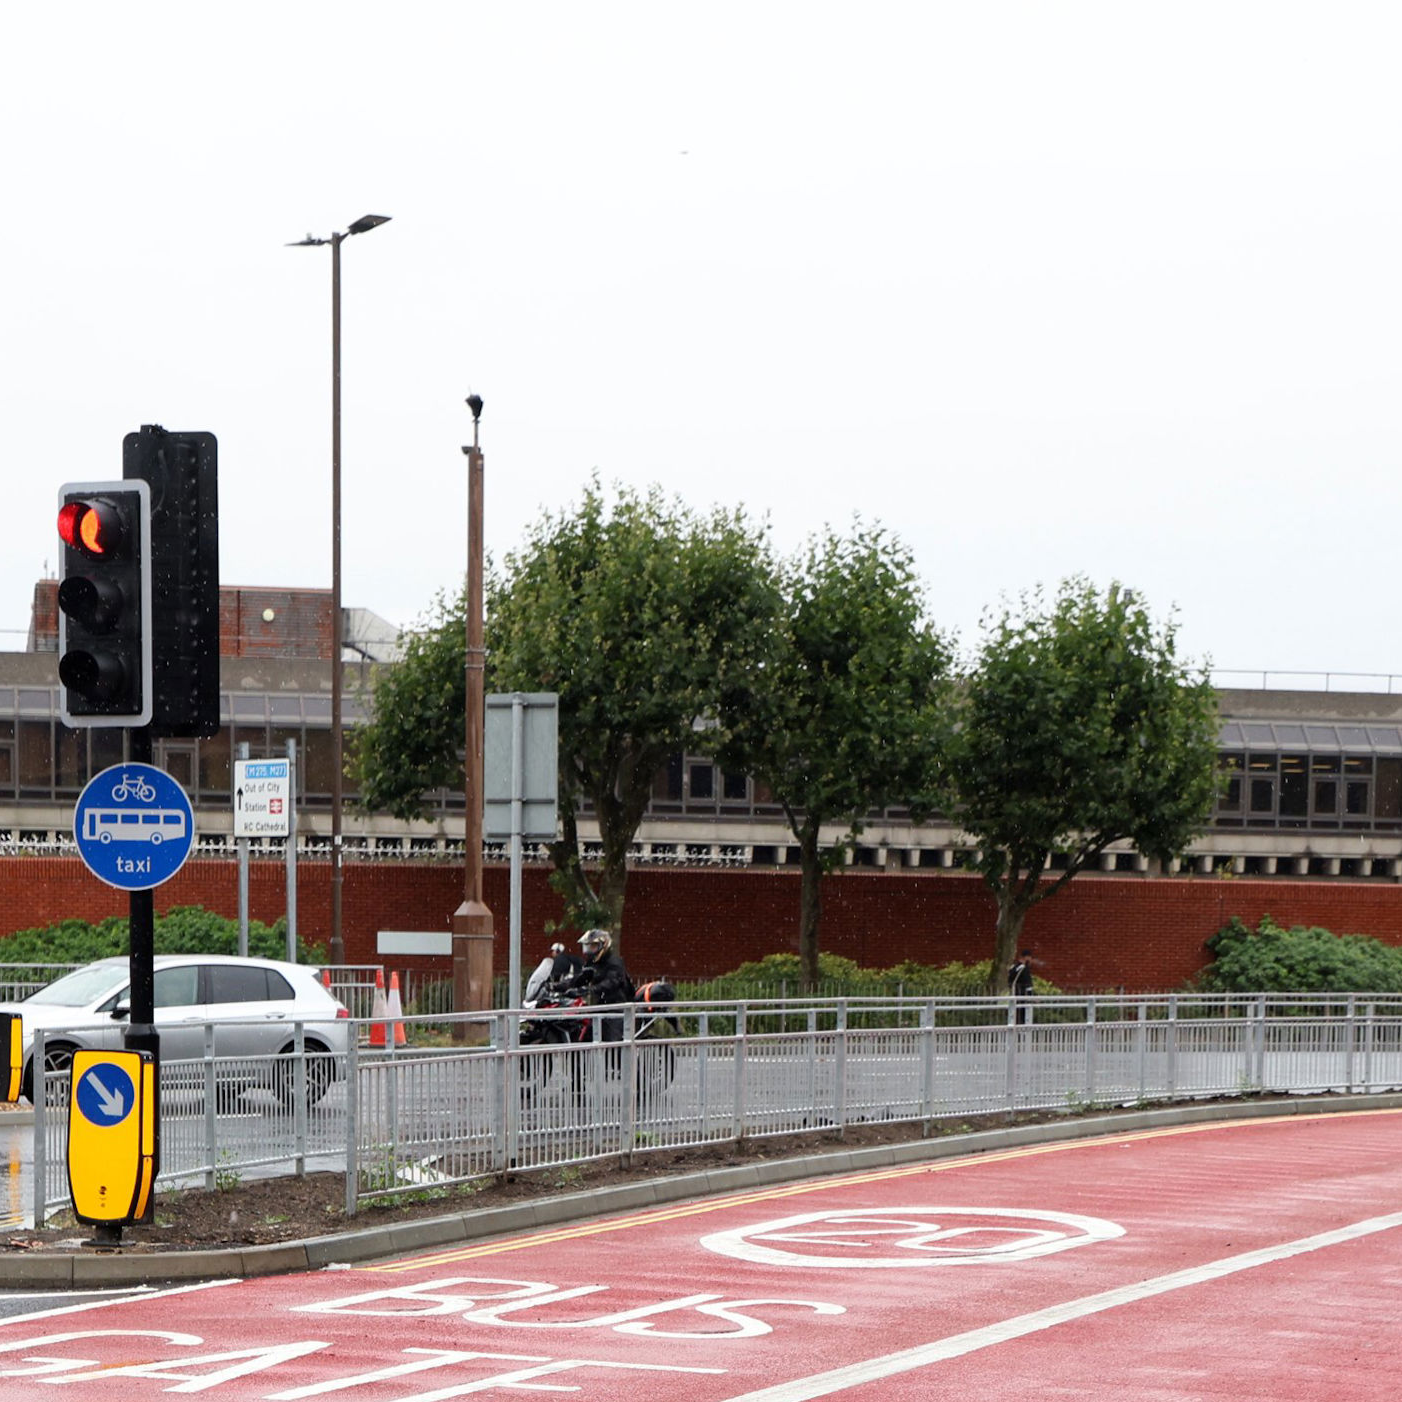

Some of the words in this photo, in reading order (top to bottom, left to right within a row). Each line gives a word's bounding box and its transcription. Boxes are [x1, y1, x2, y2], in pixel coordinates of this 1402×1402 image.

[244, 783, 256, 793] Out
[258, 782, 265, 793] of
[267, 782, 280, 794] City
[244, 802, 267, 812] Station
[244, 821, 254, 832] RC
[255, 821, 286, 832] Cathedral
[116, 856, 151, 873] taxi
[748, 1217, 1067, 1252] 20
[287, 1276, 848, 1339] BUS
